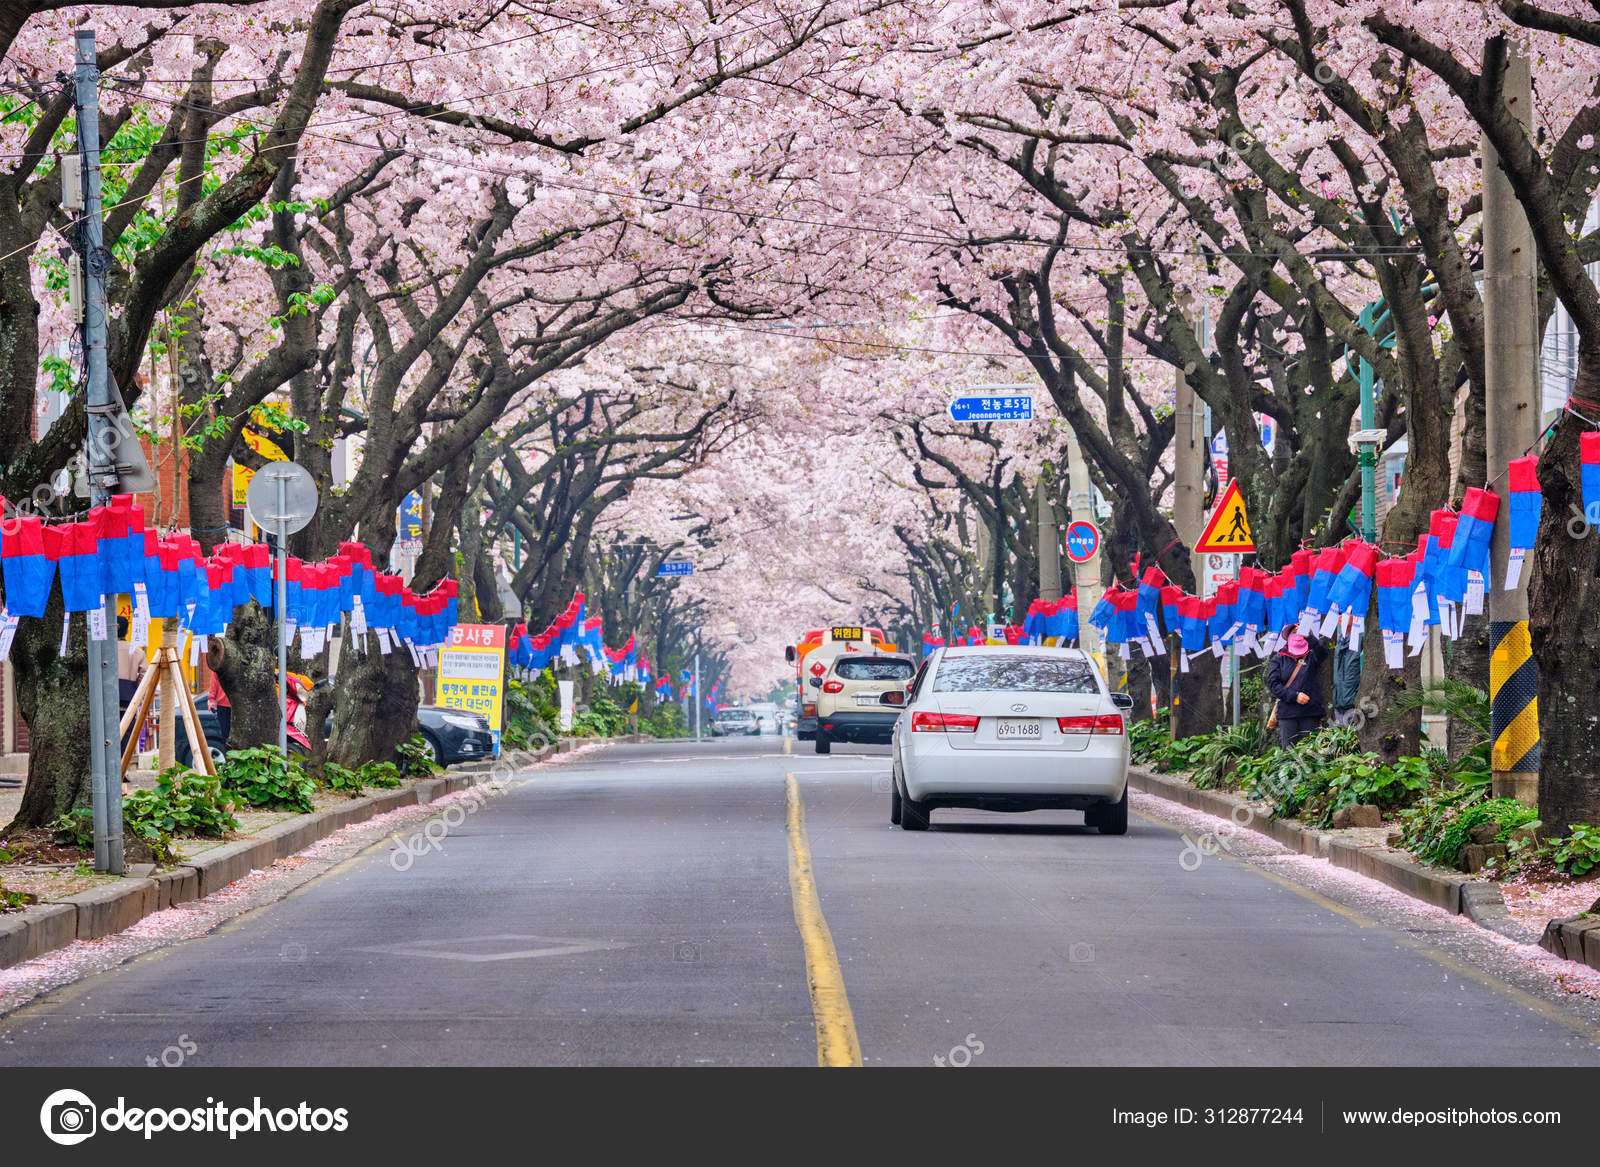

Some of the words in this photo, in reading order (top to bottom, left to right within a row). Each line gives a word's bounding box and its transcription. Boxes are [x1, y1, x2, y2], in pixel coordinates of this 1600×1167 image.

[981, 398, 1030, 410] 전농로5길
[1013, 411, 1030, 420] 5-gil
[452, 628, 494, 646] 공사중
[832, 628, 861, 639] 위험물
[442, 683, 468, 696] 통행에
[471, 685, 497, 697] 불편을
[466, 698, 493, 711] 대단히
